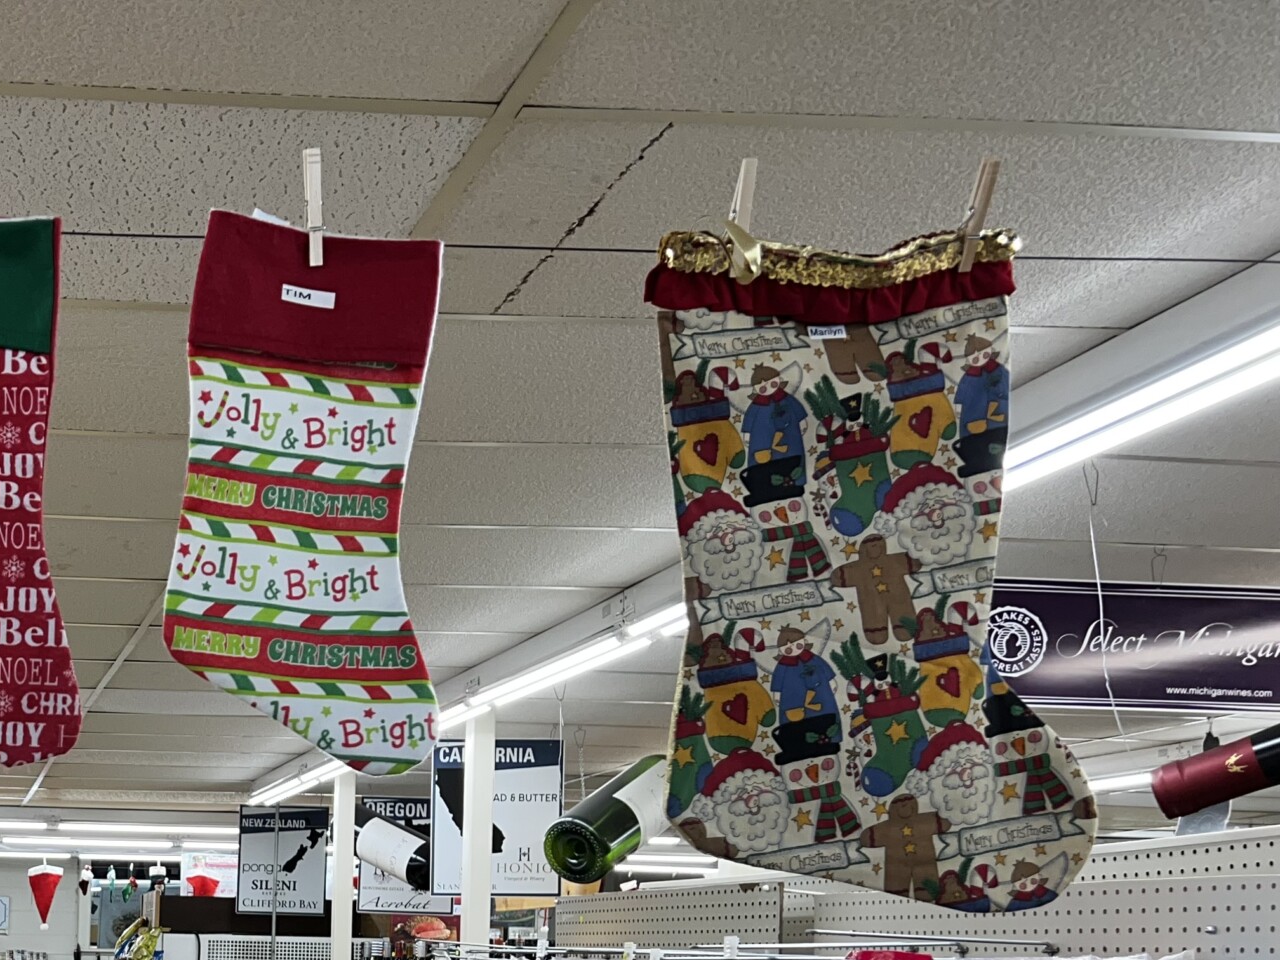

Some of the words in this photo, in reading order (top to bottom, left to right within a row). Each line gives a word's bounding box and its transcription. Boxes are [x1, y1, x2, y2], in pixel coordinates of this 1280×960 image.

[283, 288, 312, 301] TIM
[809, 326, 845, 338] Marilyn
[196, 390, 279, 441] Jolly
[280, 428, 299, 450] &
[303, 416, 397, 455] Bright
[187, 472, 256, 507] MERRY
[261, 483, 389, 520] CHRISTMAS
[175, 545, 260, 593] Jolly
[263, 579, 282, 601] &
[284, 563, 380, 603] Bright
[0, 586, 57, 614] JOY
[994, 611, 1031, 625] LAKES
[1056, 618, 1148, 659] Select
[172, 625, 260, 659] MERRY
[267, 636, 417, 671] CHRISTMAS
[1025, 628, 1043, 667] TASTES
[992, 658, 1026, 672] GREAT
[1166, 686, 1273, 698] www.michiganwines.com
[316, 728, 336, 750] &
[338, 711, 437, 751] Bright
[439, 747, 535, 763] CARNIA
[510, 793, 516, 802] &
[519, 793, 558, 802] BUTTER
[366, 802, 428, 818] OREGON
[242, 818, 264, 827] NEW
[496, 862, 554, 874] HONIG
[251, 879, 297, 891] SILENI
[242, 898, 296, 908] CLIFFORD
[299, 899, 318, 909] BAY
[361, 893, 431, 910] Acrobat
